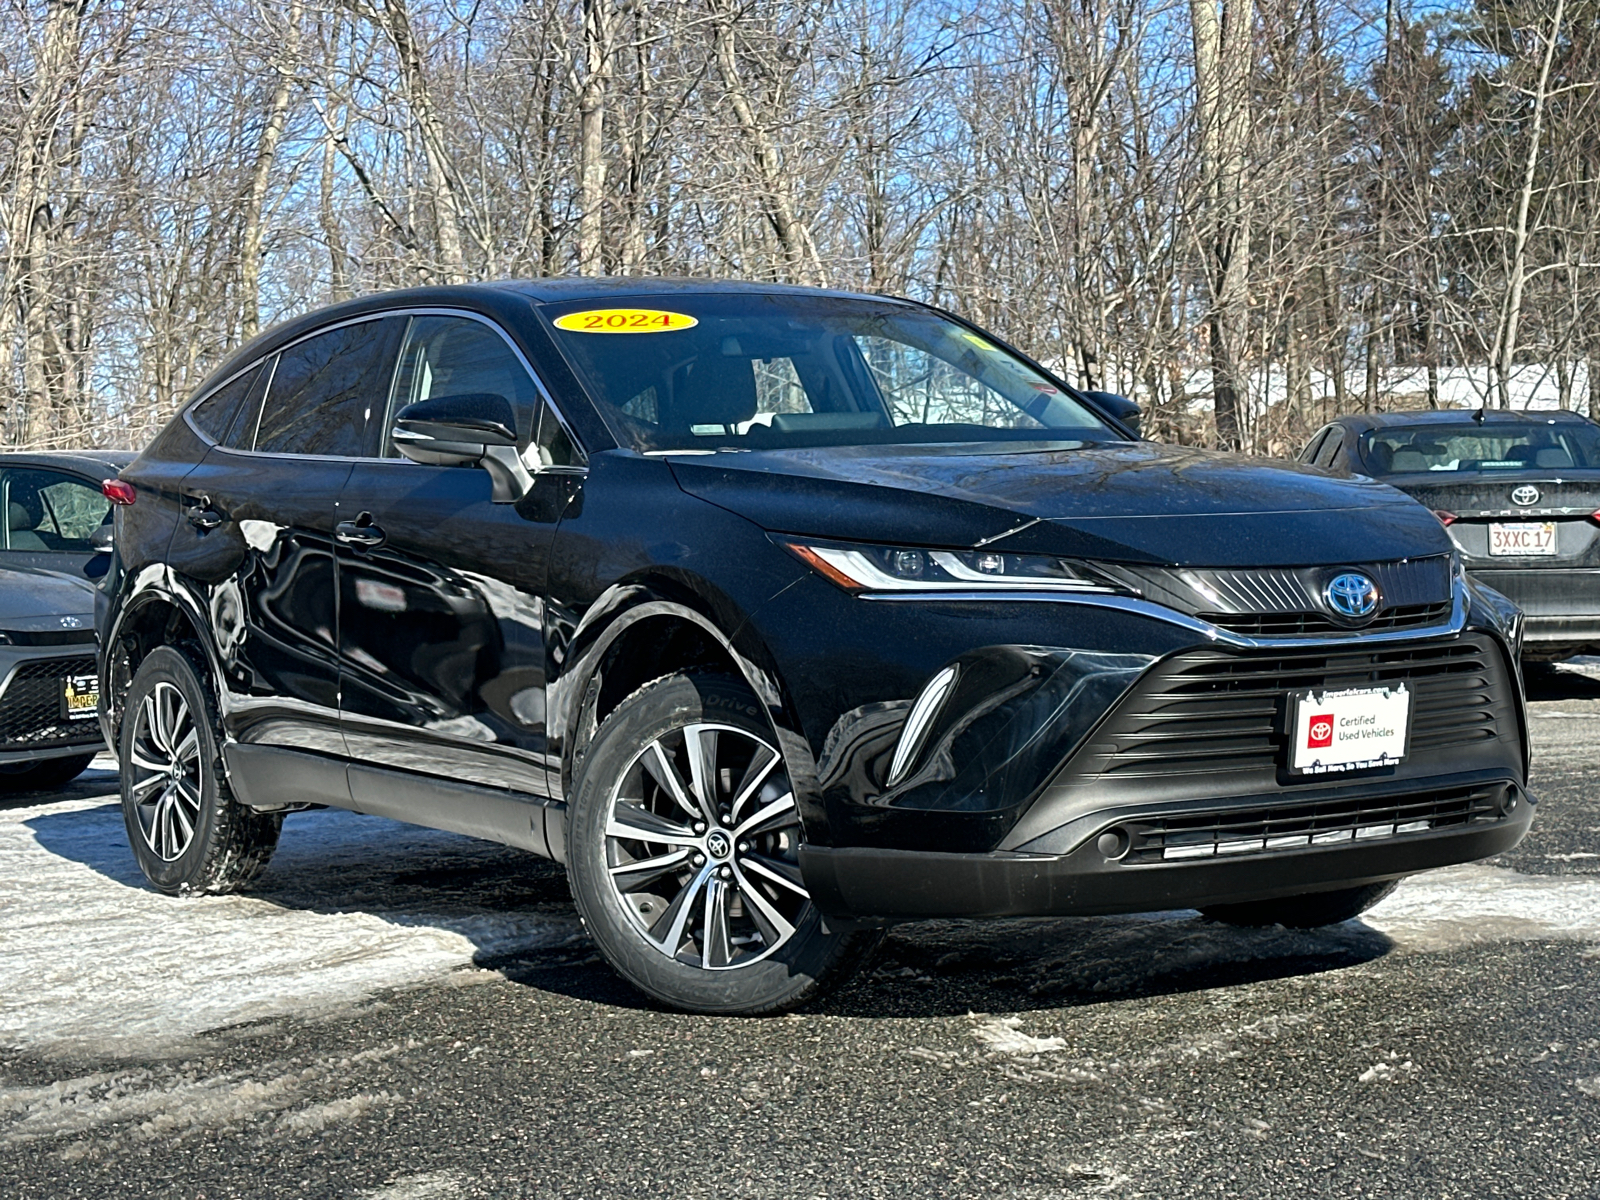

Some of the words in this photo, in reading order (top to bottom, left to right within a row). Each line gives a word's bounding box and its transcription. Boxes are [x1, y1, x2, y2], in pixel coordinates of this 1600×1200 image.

[584, 314, 674, 329] 2024
[1493, 531, 1530, 548] 3XXC
[1535, 530, 1552, 548] 17
[1339, 714, 1376, 727] Certified
[1338, 729, 1360, 741] Used
[1361, 727, 1395, 739] Vehicles
